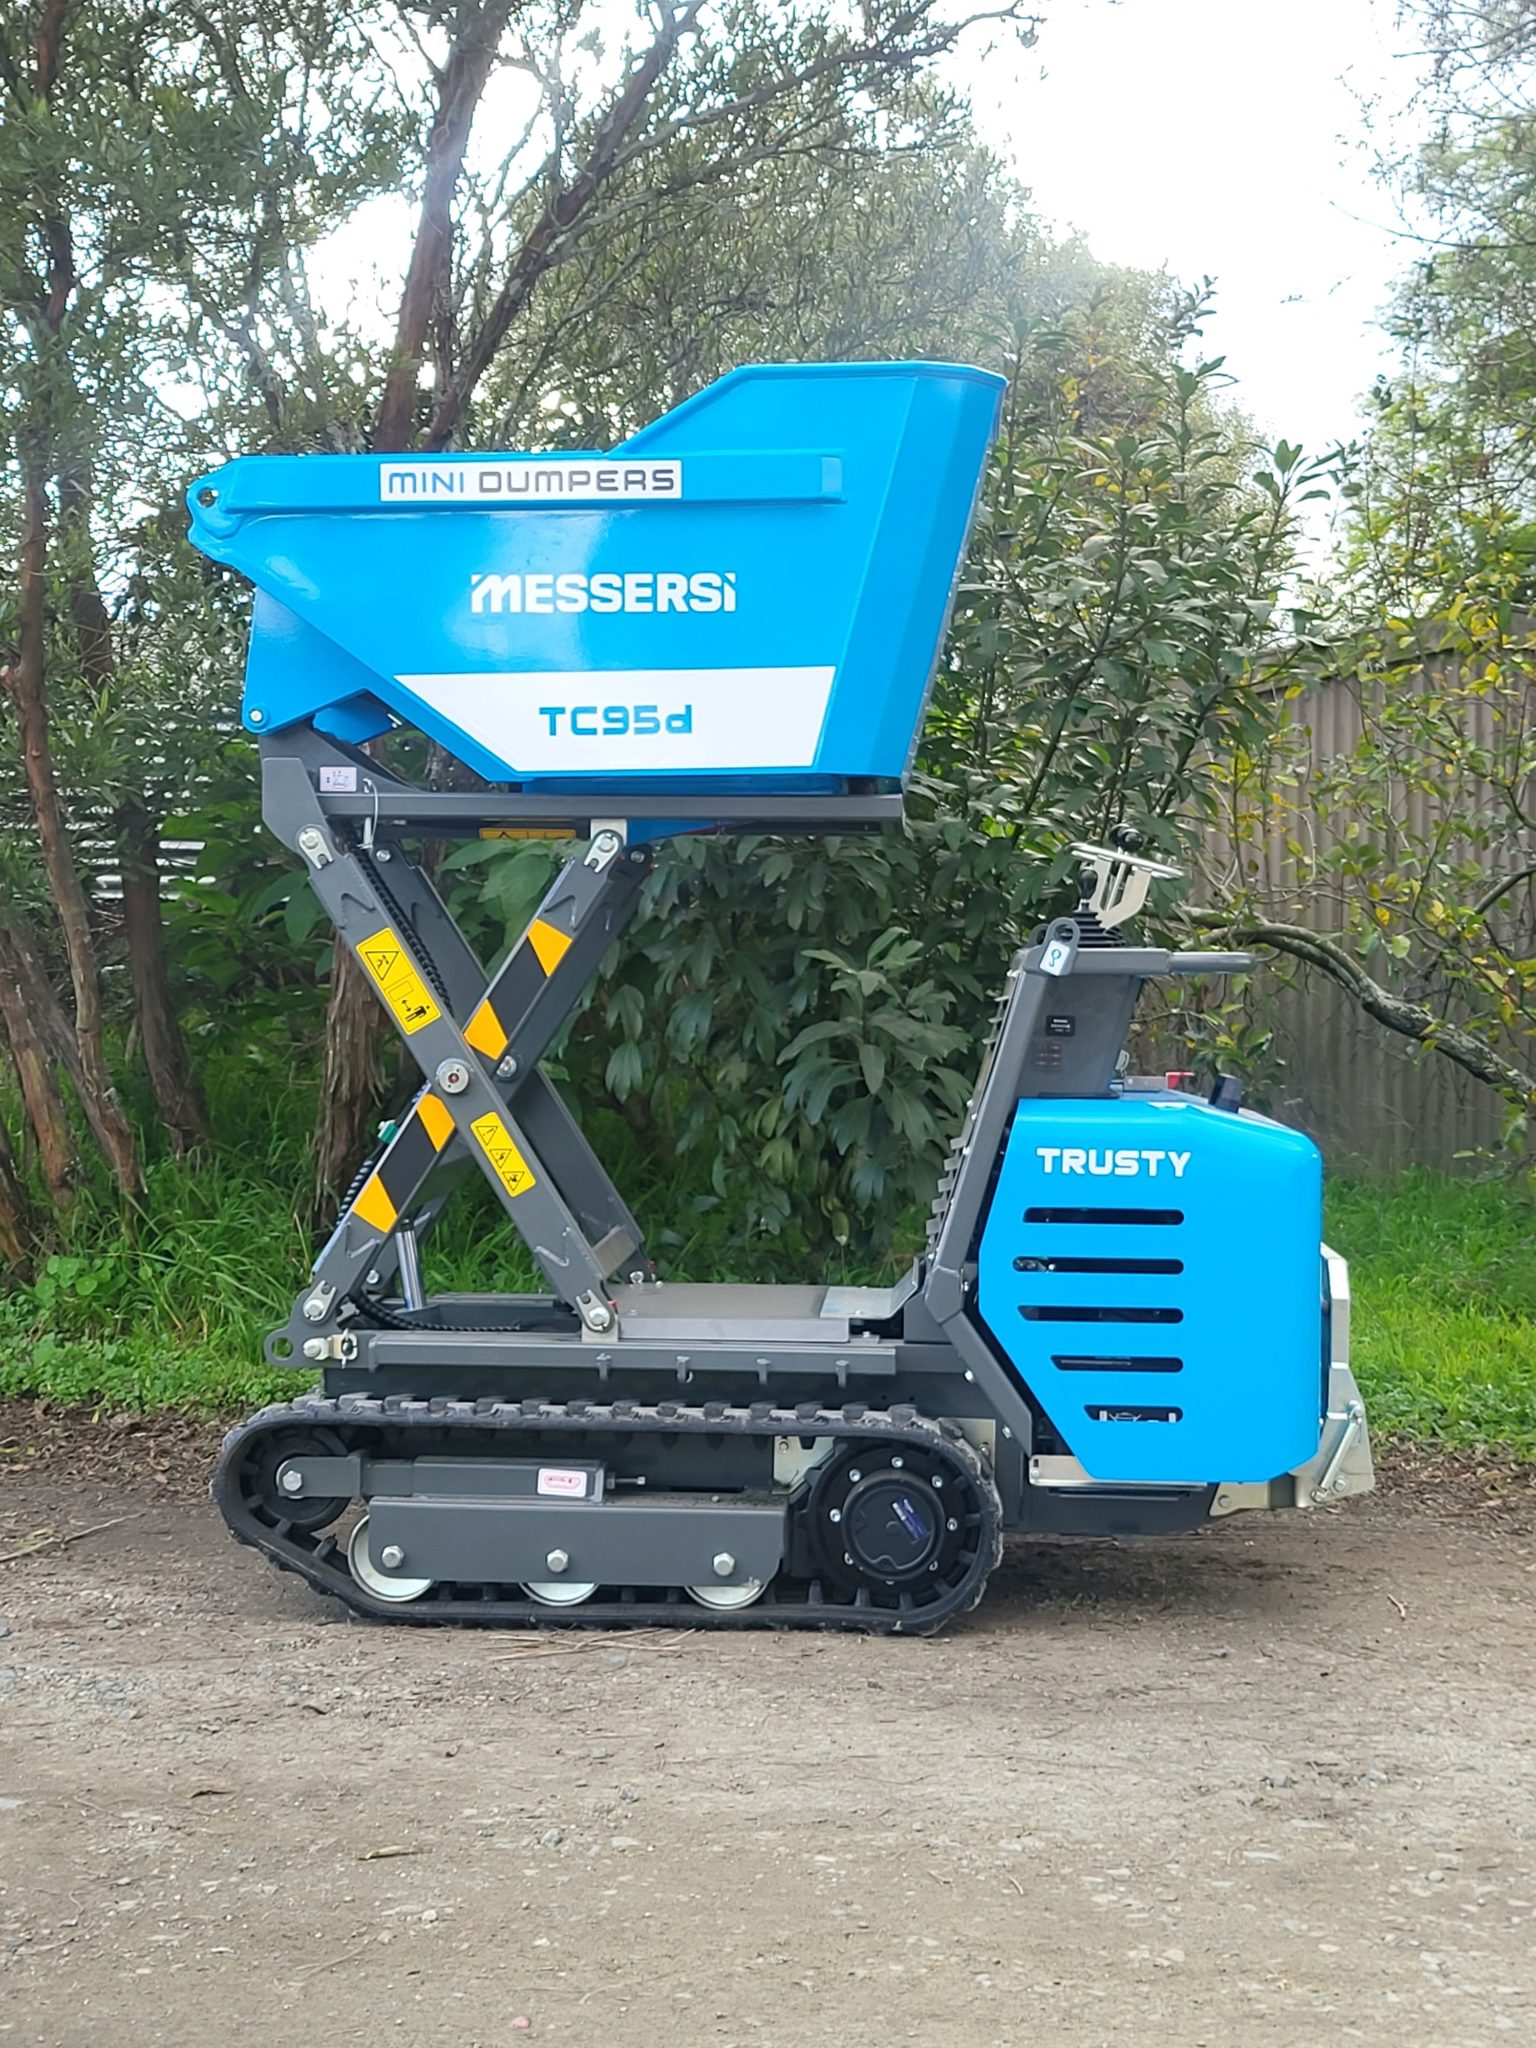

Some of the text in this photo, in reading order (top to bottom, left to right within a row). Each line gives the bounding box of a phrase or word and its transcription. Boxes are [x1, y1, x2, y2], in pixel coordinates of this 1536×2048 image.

[388, 469, 675, 493] MINI DUMPERS
[538, 705, 692, 735] TC95d
[1037, 1147, 1191, 1177] TRUSTY
